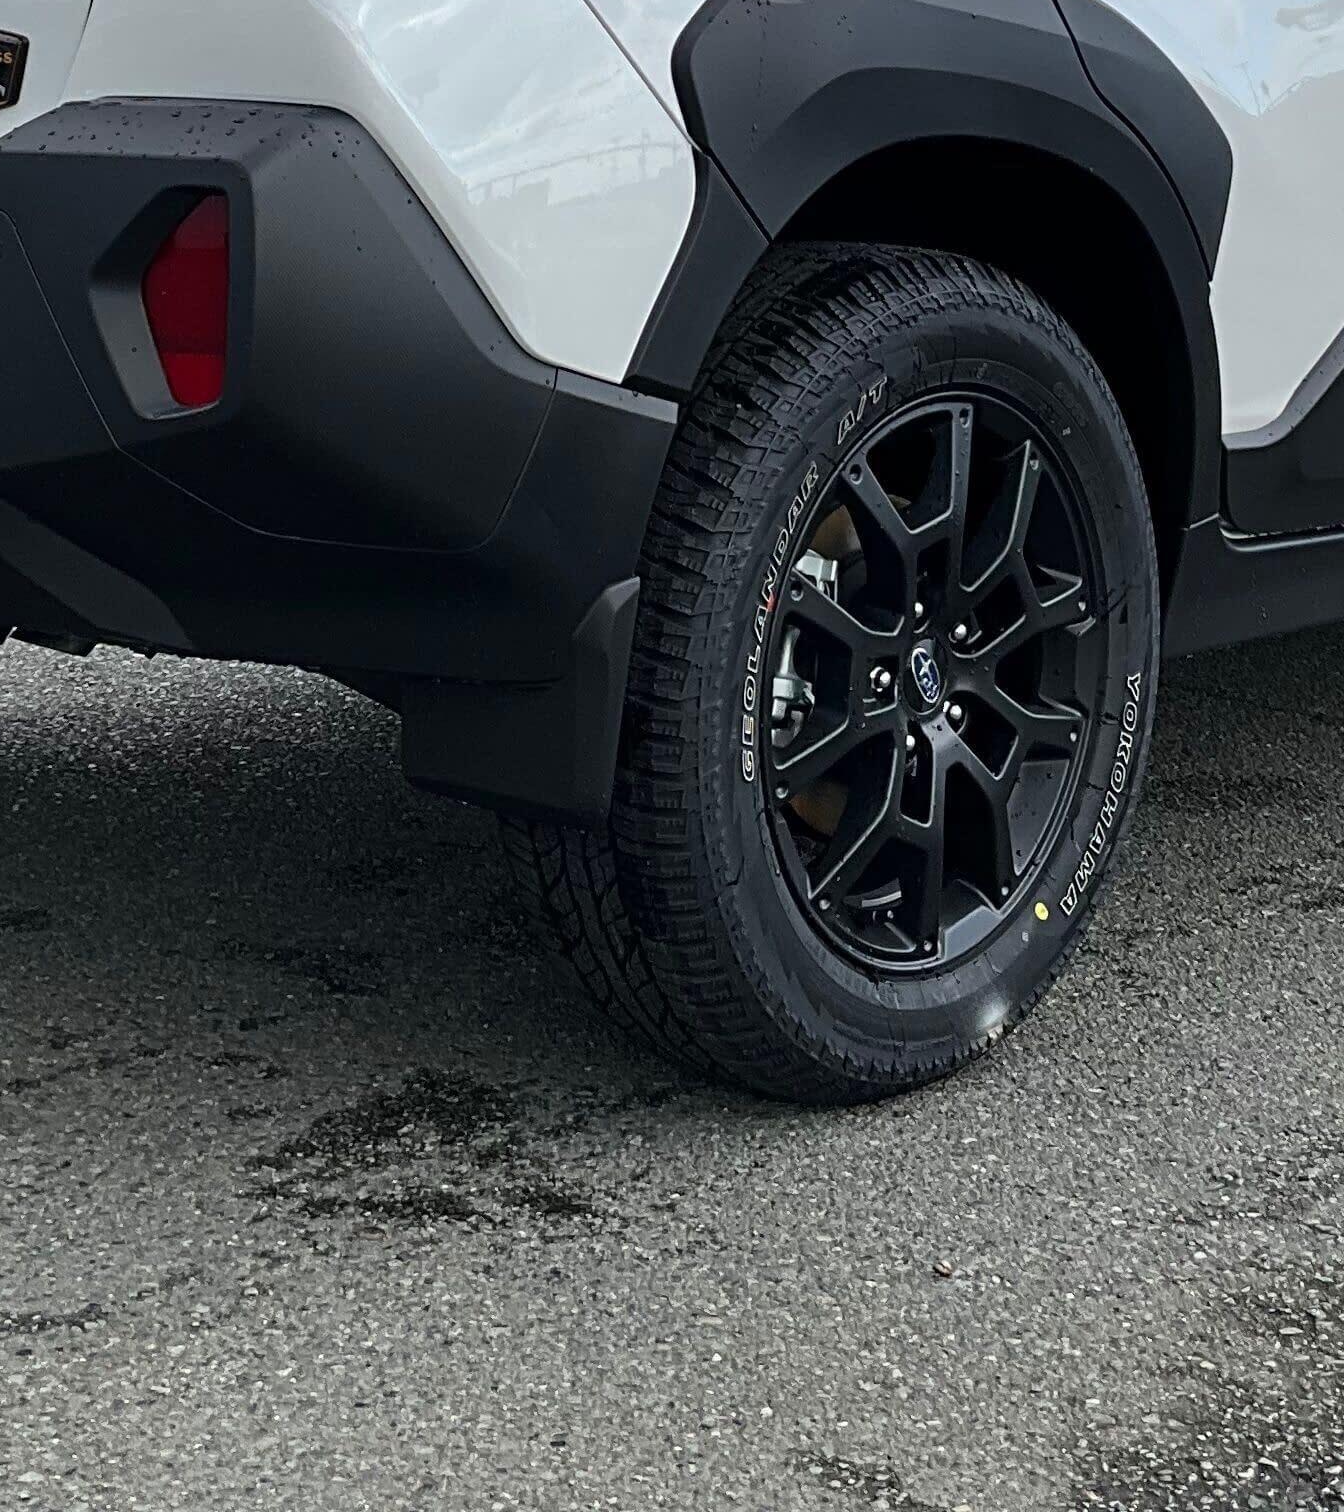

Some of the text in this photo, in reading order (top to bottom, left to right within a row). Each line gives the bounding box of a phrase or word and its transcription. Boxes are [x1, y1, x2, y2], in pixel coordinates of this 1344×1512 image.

[742, 376, 887, 781] GEOLANDAR A/T
[1060, 672, 1141, 915] YOKOHAMA
